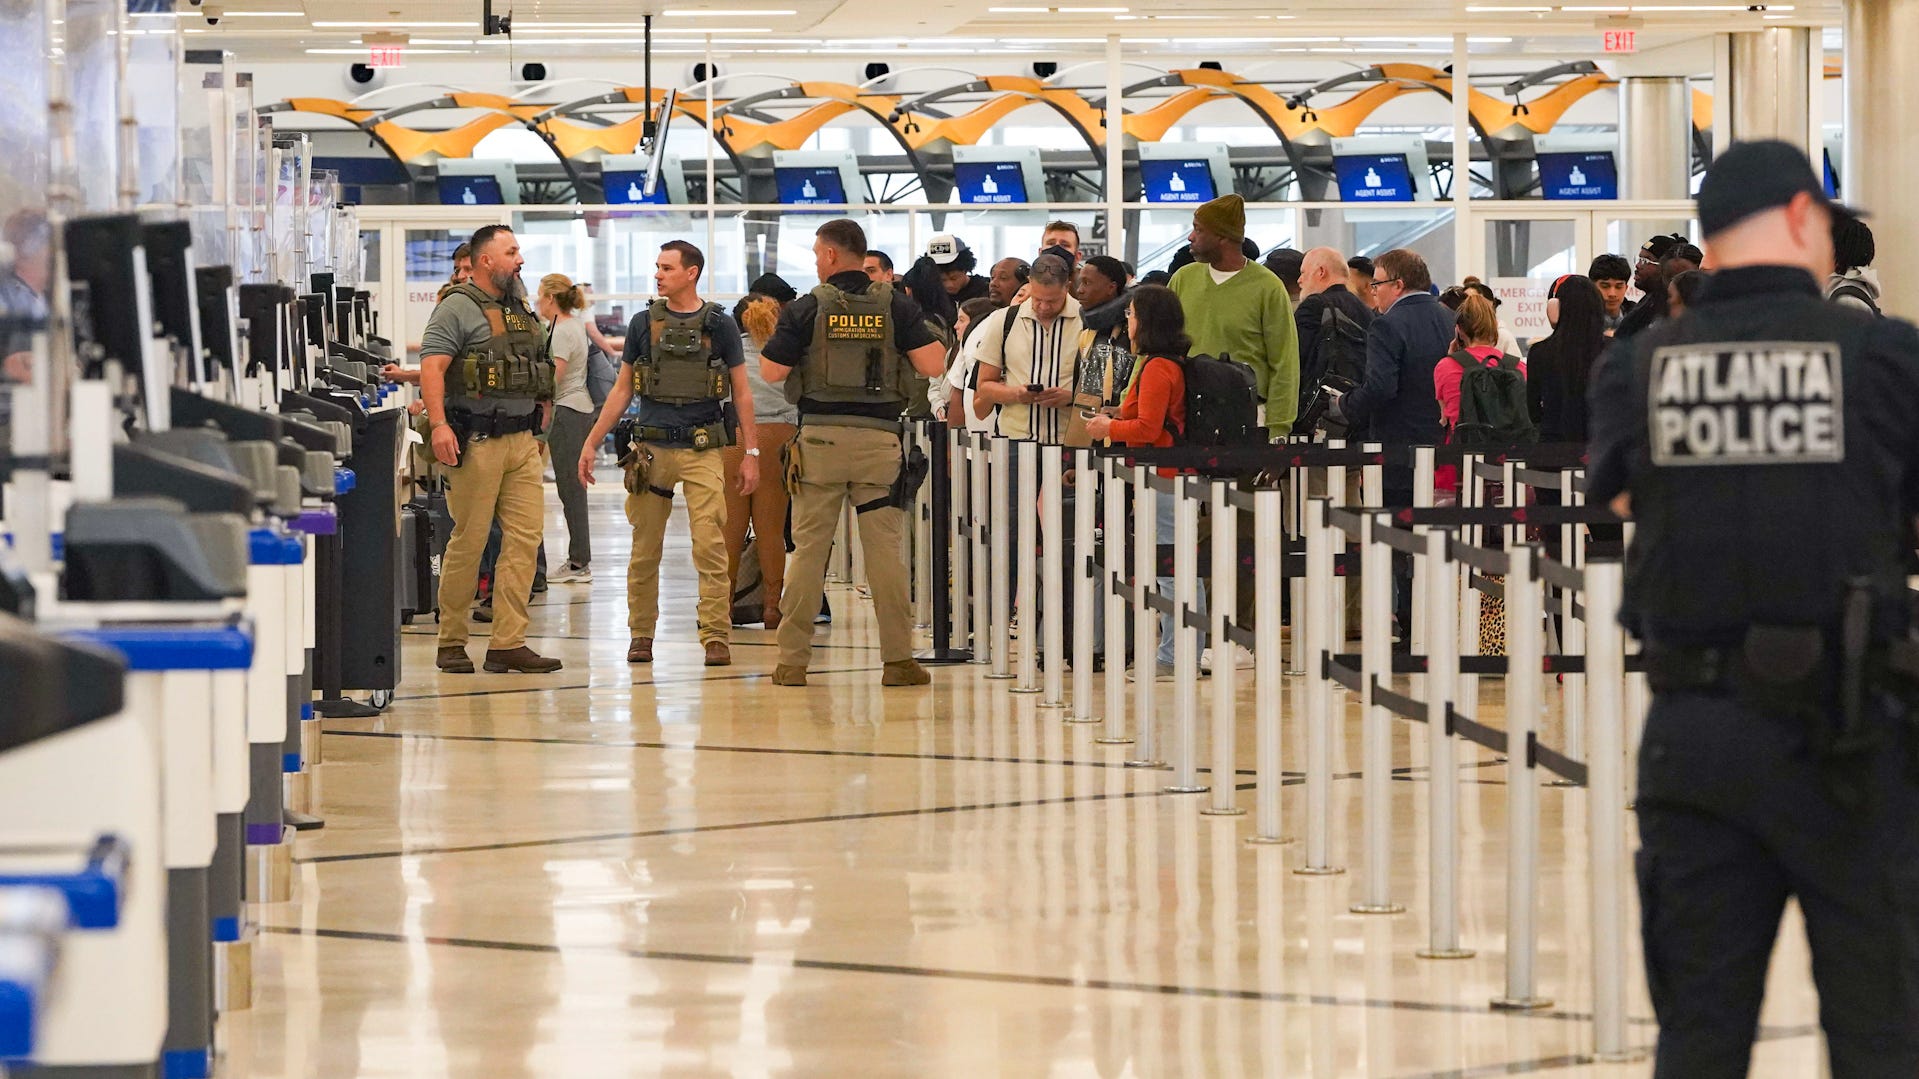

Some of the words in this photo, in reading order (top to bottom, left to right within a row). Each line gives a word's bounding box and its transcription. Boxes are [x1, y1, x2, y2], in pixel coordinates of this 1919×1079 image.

[1604, 31, 1636, 51] EXIT
[370, 47, 402, 66] EXIT
[1180, 192, 1200, 200] ASSIST
[1355, 189, 1375, 197] AGENT
[1376, 188, 1396, 196] ASSIST
[1558, 187, 1580, 195] AGENT
[1581, 186, 1602, 194] ASSIST
[973, 195, 992, 203] AGENT
[1517, 302, 1543, 313] EXIT
[829, 314, 884, 328] POLICE
[1514, 316, 1546, 328] ONLY
[487, 367, 496, 387] ERO
[1660, 352, 1832, 403] ATLANTA
[1658, 402, 1837, 457] POLICE
